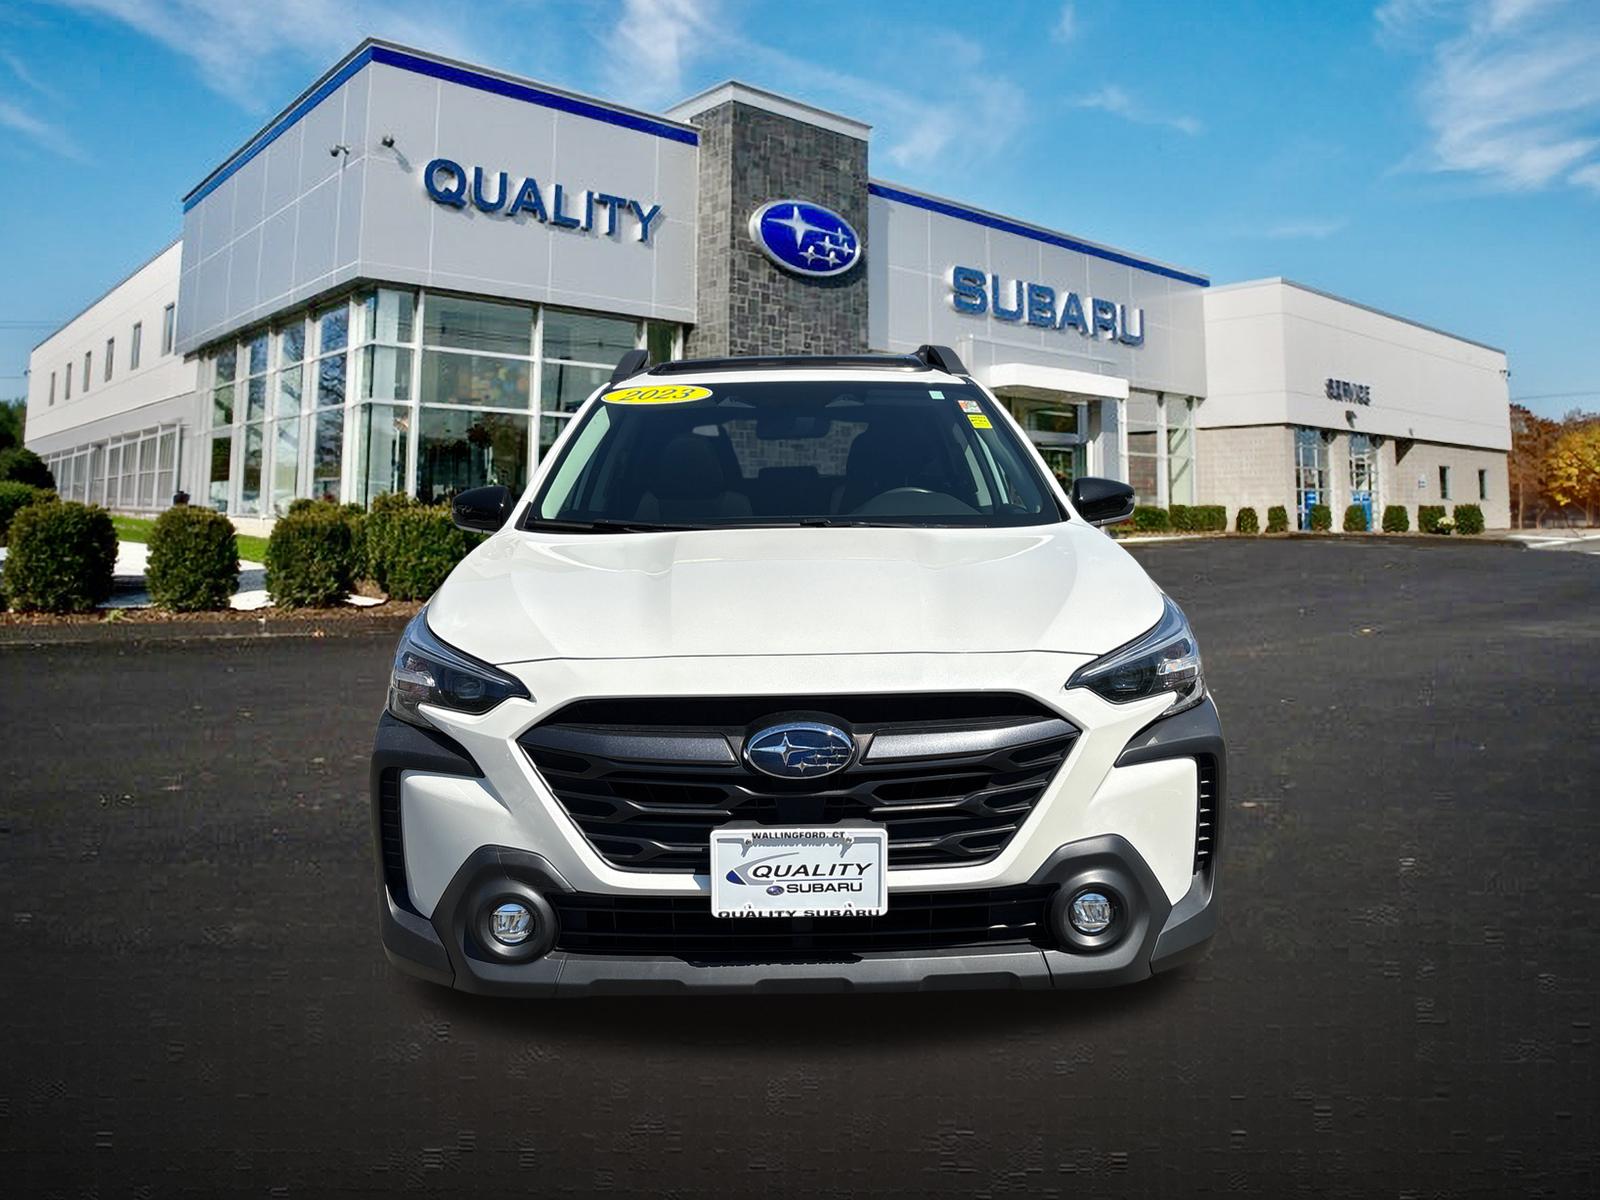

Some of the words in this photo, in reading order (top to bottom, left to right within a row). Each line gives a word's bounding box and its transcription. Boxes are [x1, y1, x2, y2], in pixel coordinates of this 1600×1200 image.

[424, 158, 662, 243] QUALITY
[951, 265, 1145, 347] SUBARU
[619, 388, 695, 401] 2023
[832, 831, 846, 839] CT
[753, 863, 873, 878] QUALITY
[787, 882, 862, 893] SUBARU
[718, 909, 797, 919] QUALITY
[804, 909, 880, 918] SUBARU
